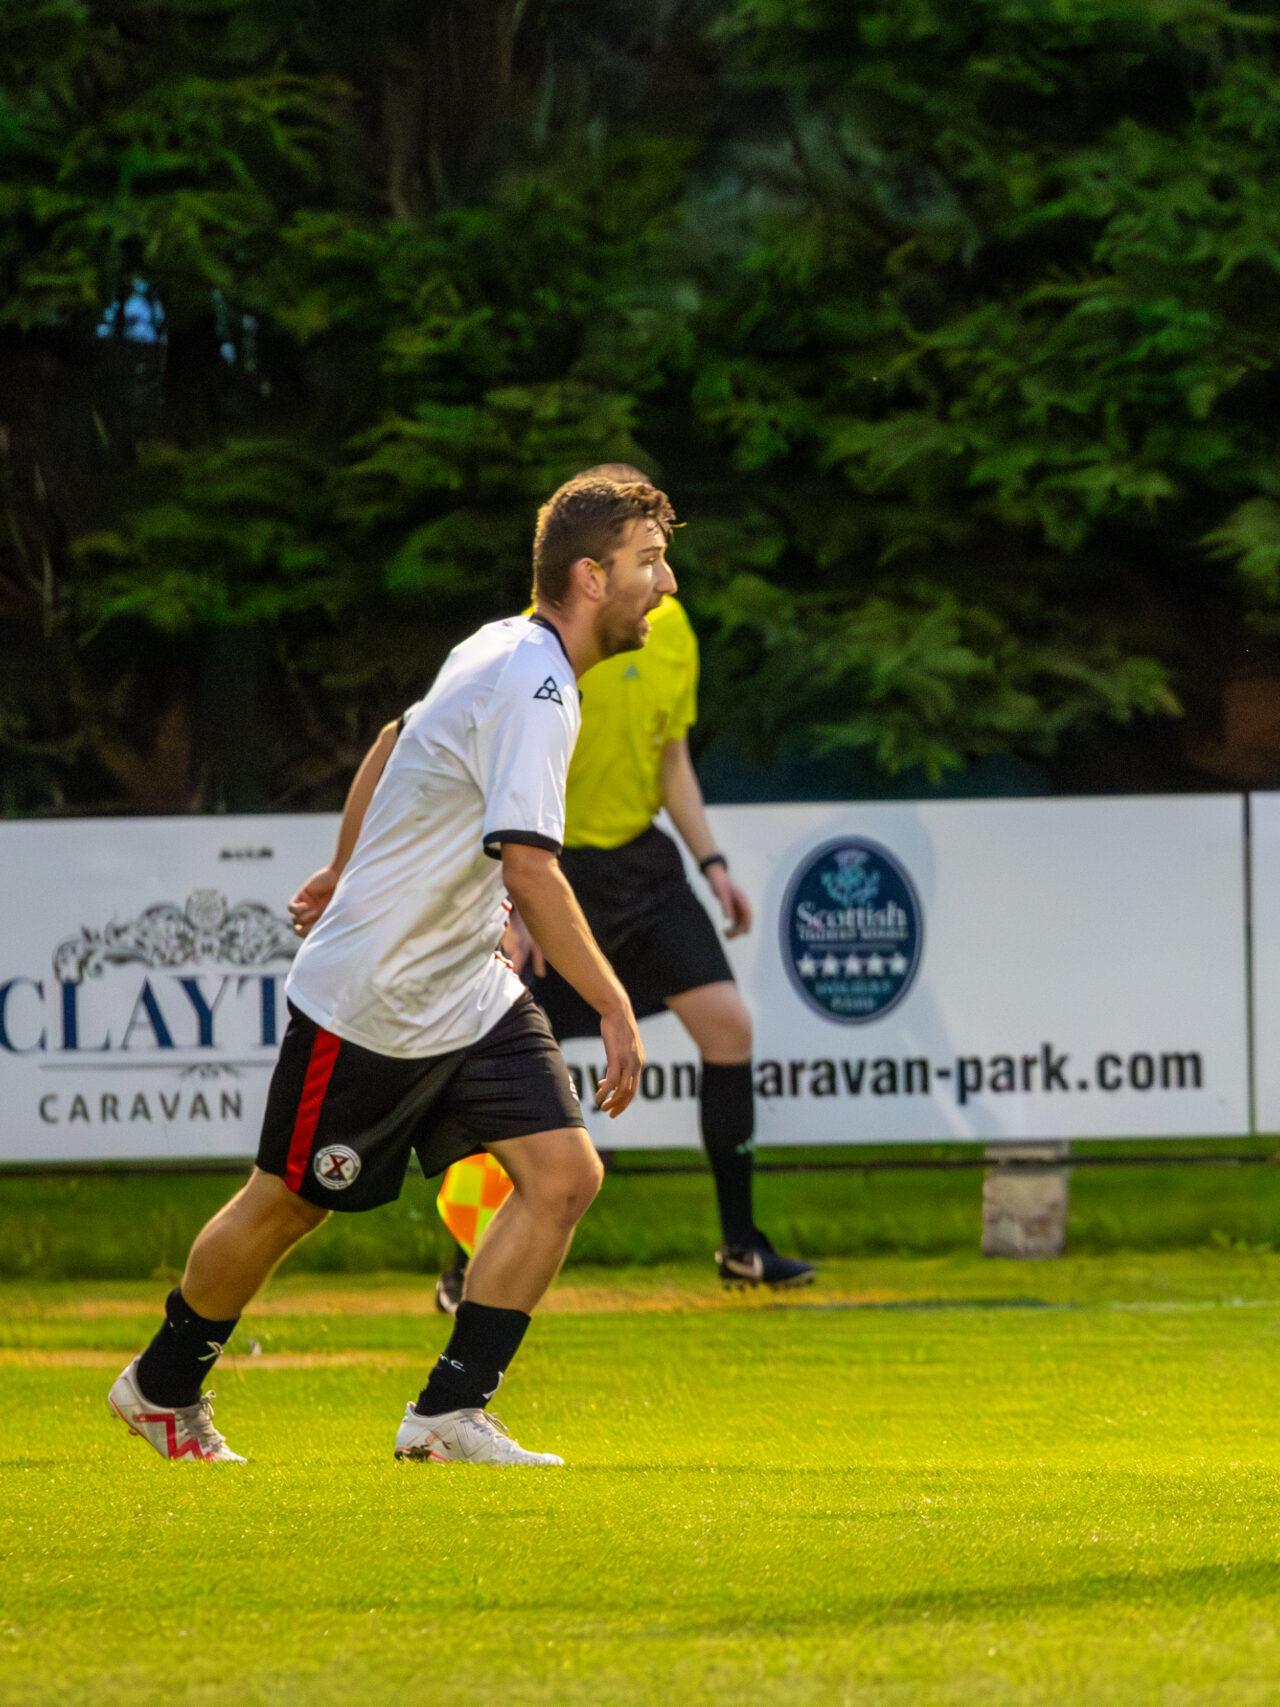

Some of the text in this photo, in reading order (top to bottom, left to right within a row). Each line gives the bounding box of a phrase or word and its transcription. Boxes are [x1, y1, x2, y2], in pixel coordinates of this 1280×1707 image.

[796, 900, 908, 928] Scottish
[0, 973, 289, 1056] CLAYT
[38, 1091, 244, 1124] CARAVAN
